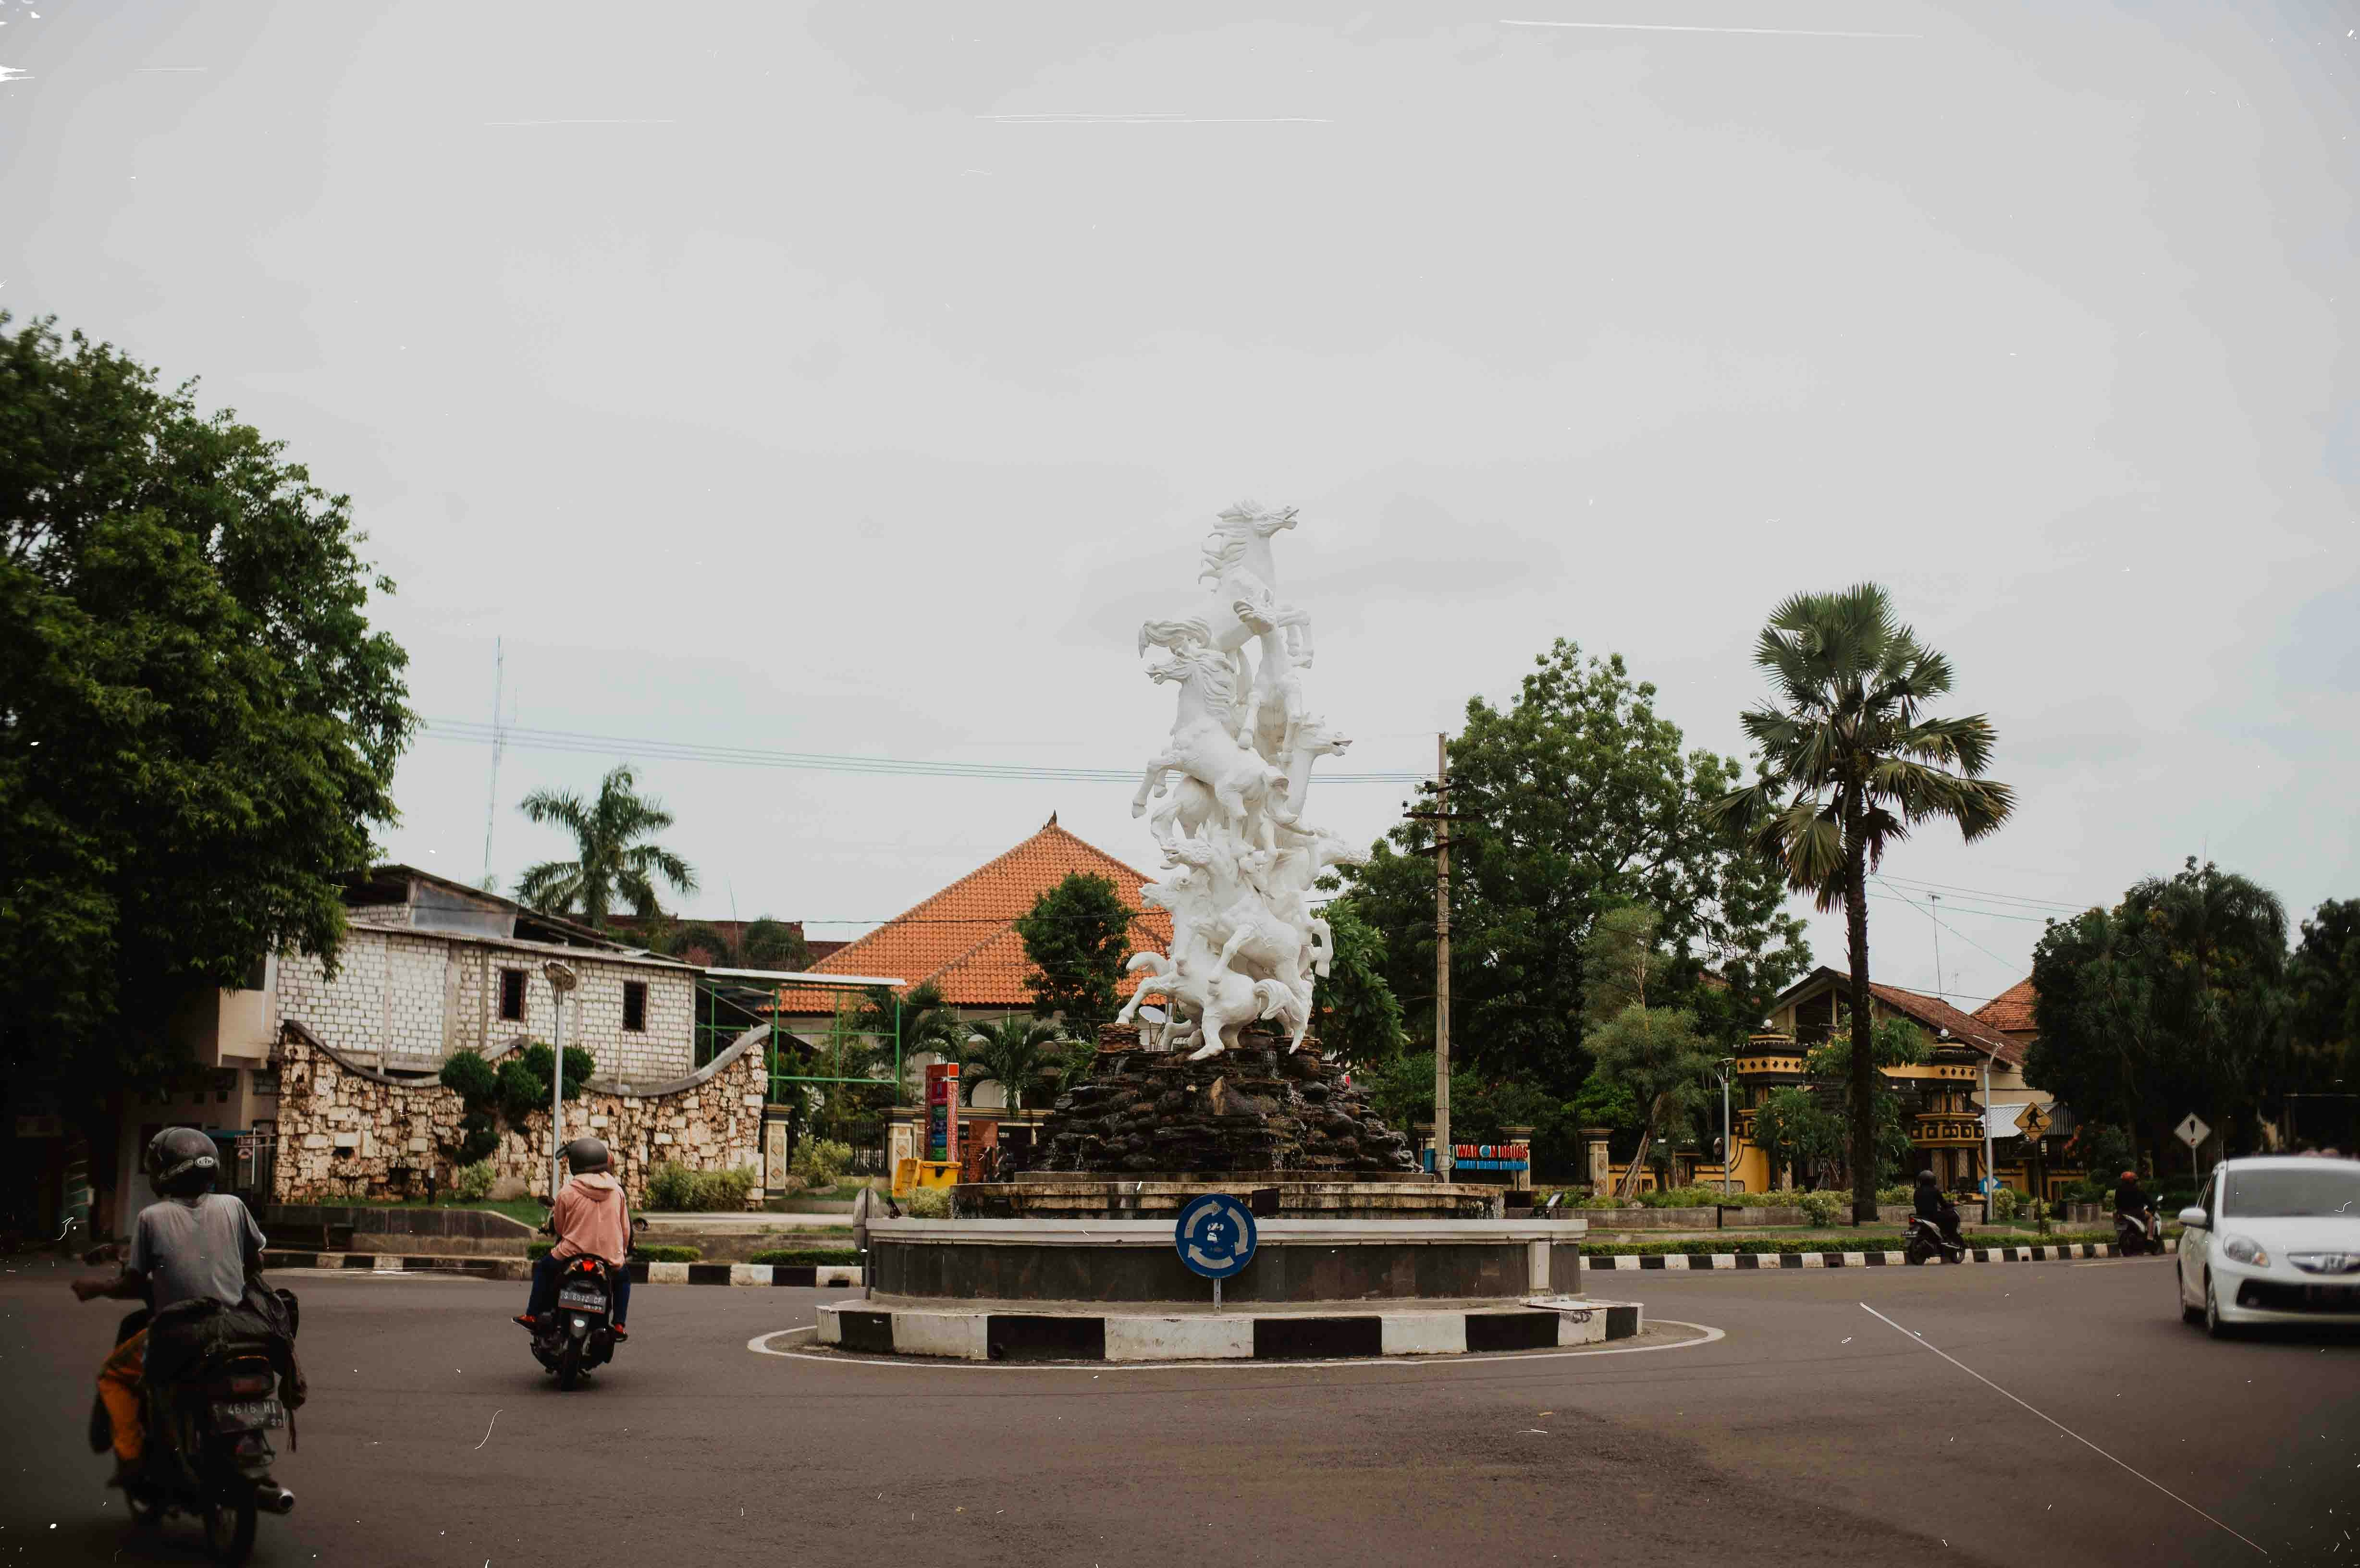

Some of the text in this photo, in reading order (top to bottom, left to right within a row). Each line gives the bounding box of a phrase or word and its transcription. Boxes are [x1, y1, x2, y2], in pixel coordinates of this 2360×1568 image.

[1455, 1144, 1528, 1158] WAR ON DRUGS
